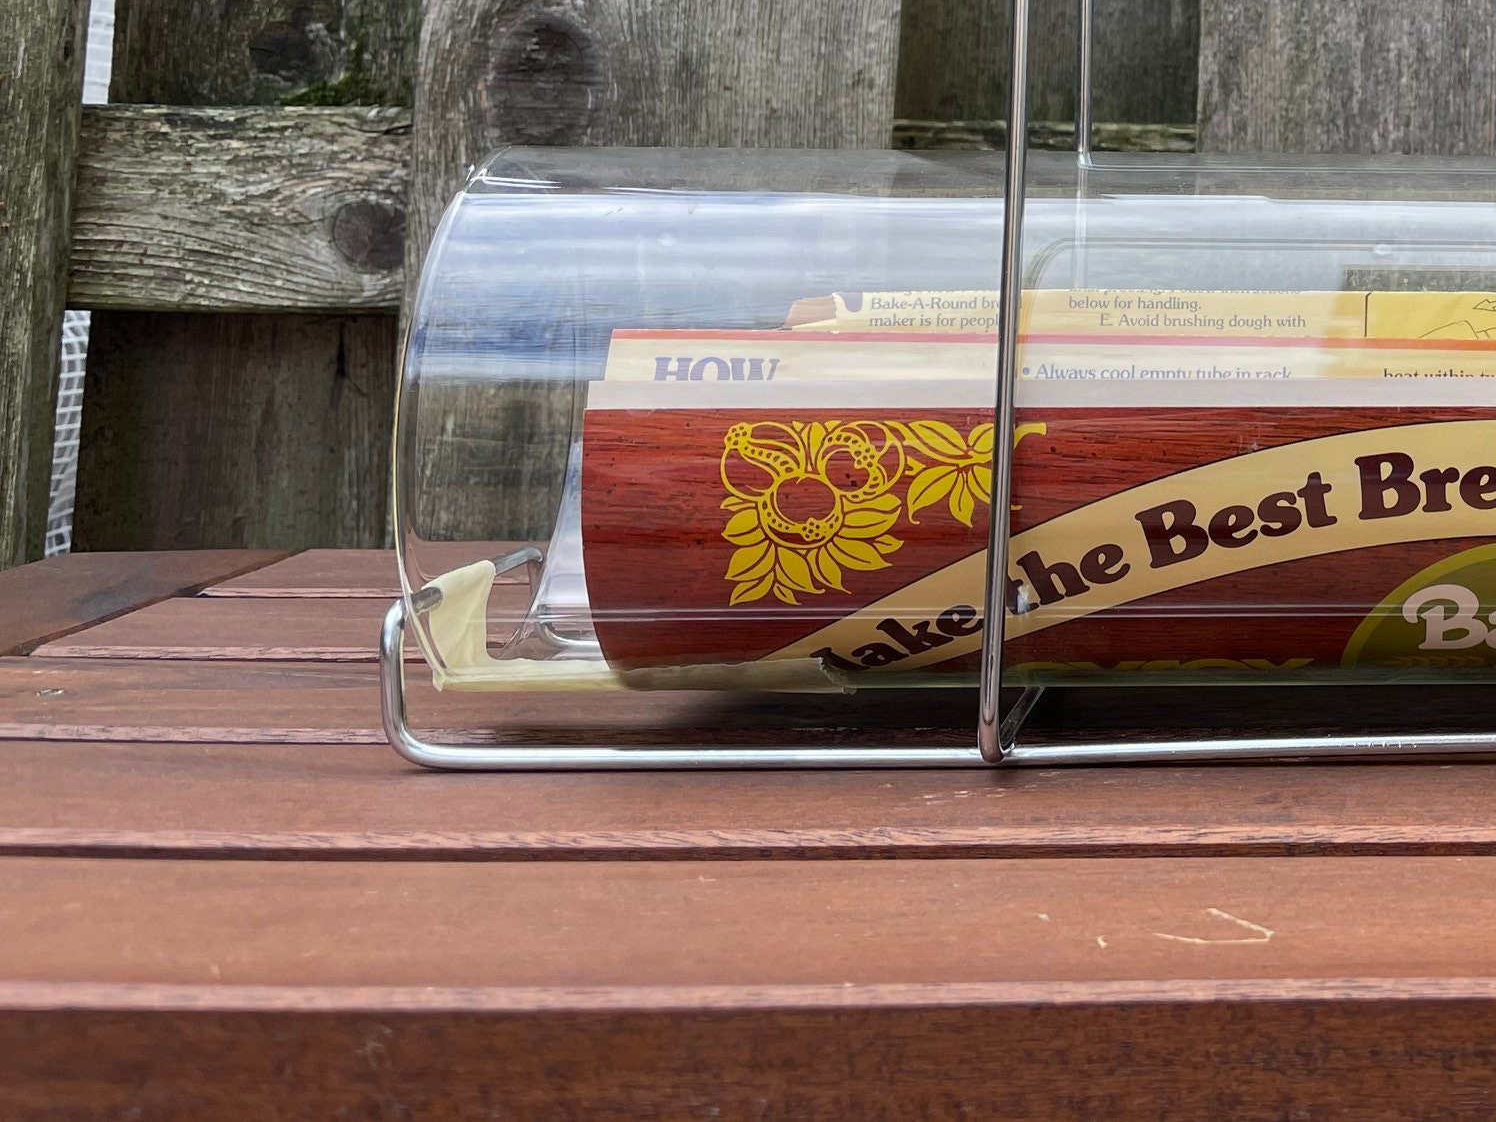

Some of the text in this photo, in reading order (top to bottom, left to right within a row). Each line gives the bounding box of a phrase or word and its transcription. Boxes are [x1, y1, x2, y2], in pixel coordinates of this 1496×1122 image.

[870, 296, 977, 310] Bake-A-Round
[1069, 296, 1202, 312] below for handling.
[869, 313, 914, 327] maker
[920, 314, 931, 327] is
[936, 313, 955, 327] for
[1118, 313, 1160, 327] Avoid
[1163, 314, 1224, 329] brushing
[1228, 314, 1272, 329] dough
[1276, 314, 1306, 328] with
[1135, 471, 1338, 569] Best
